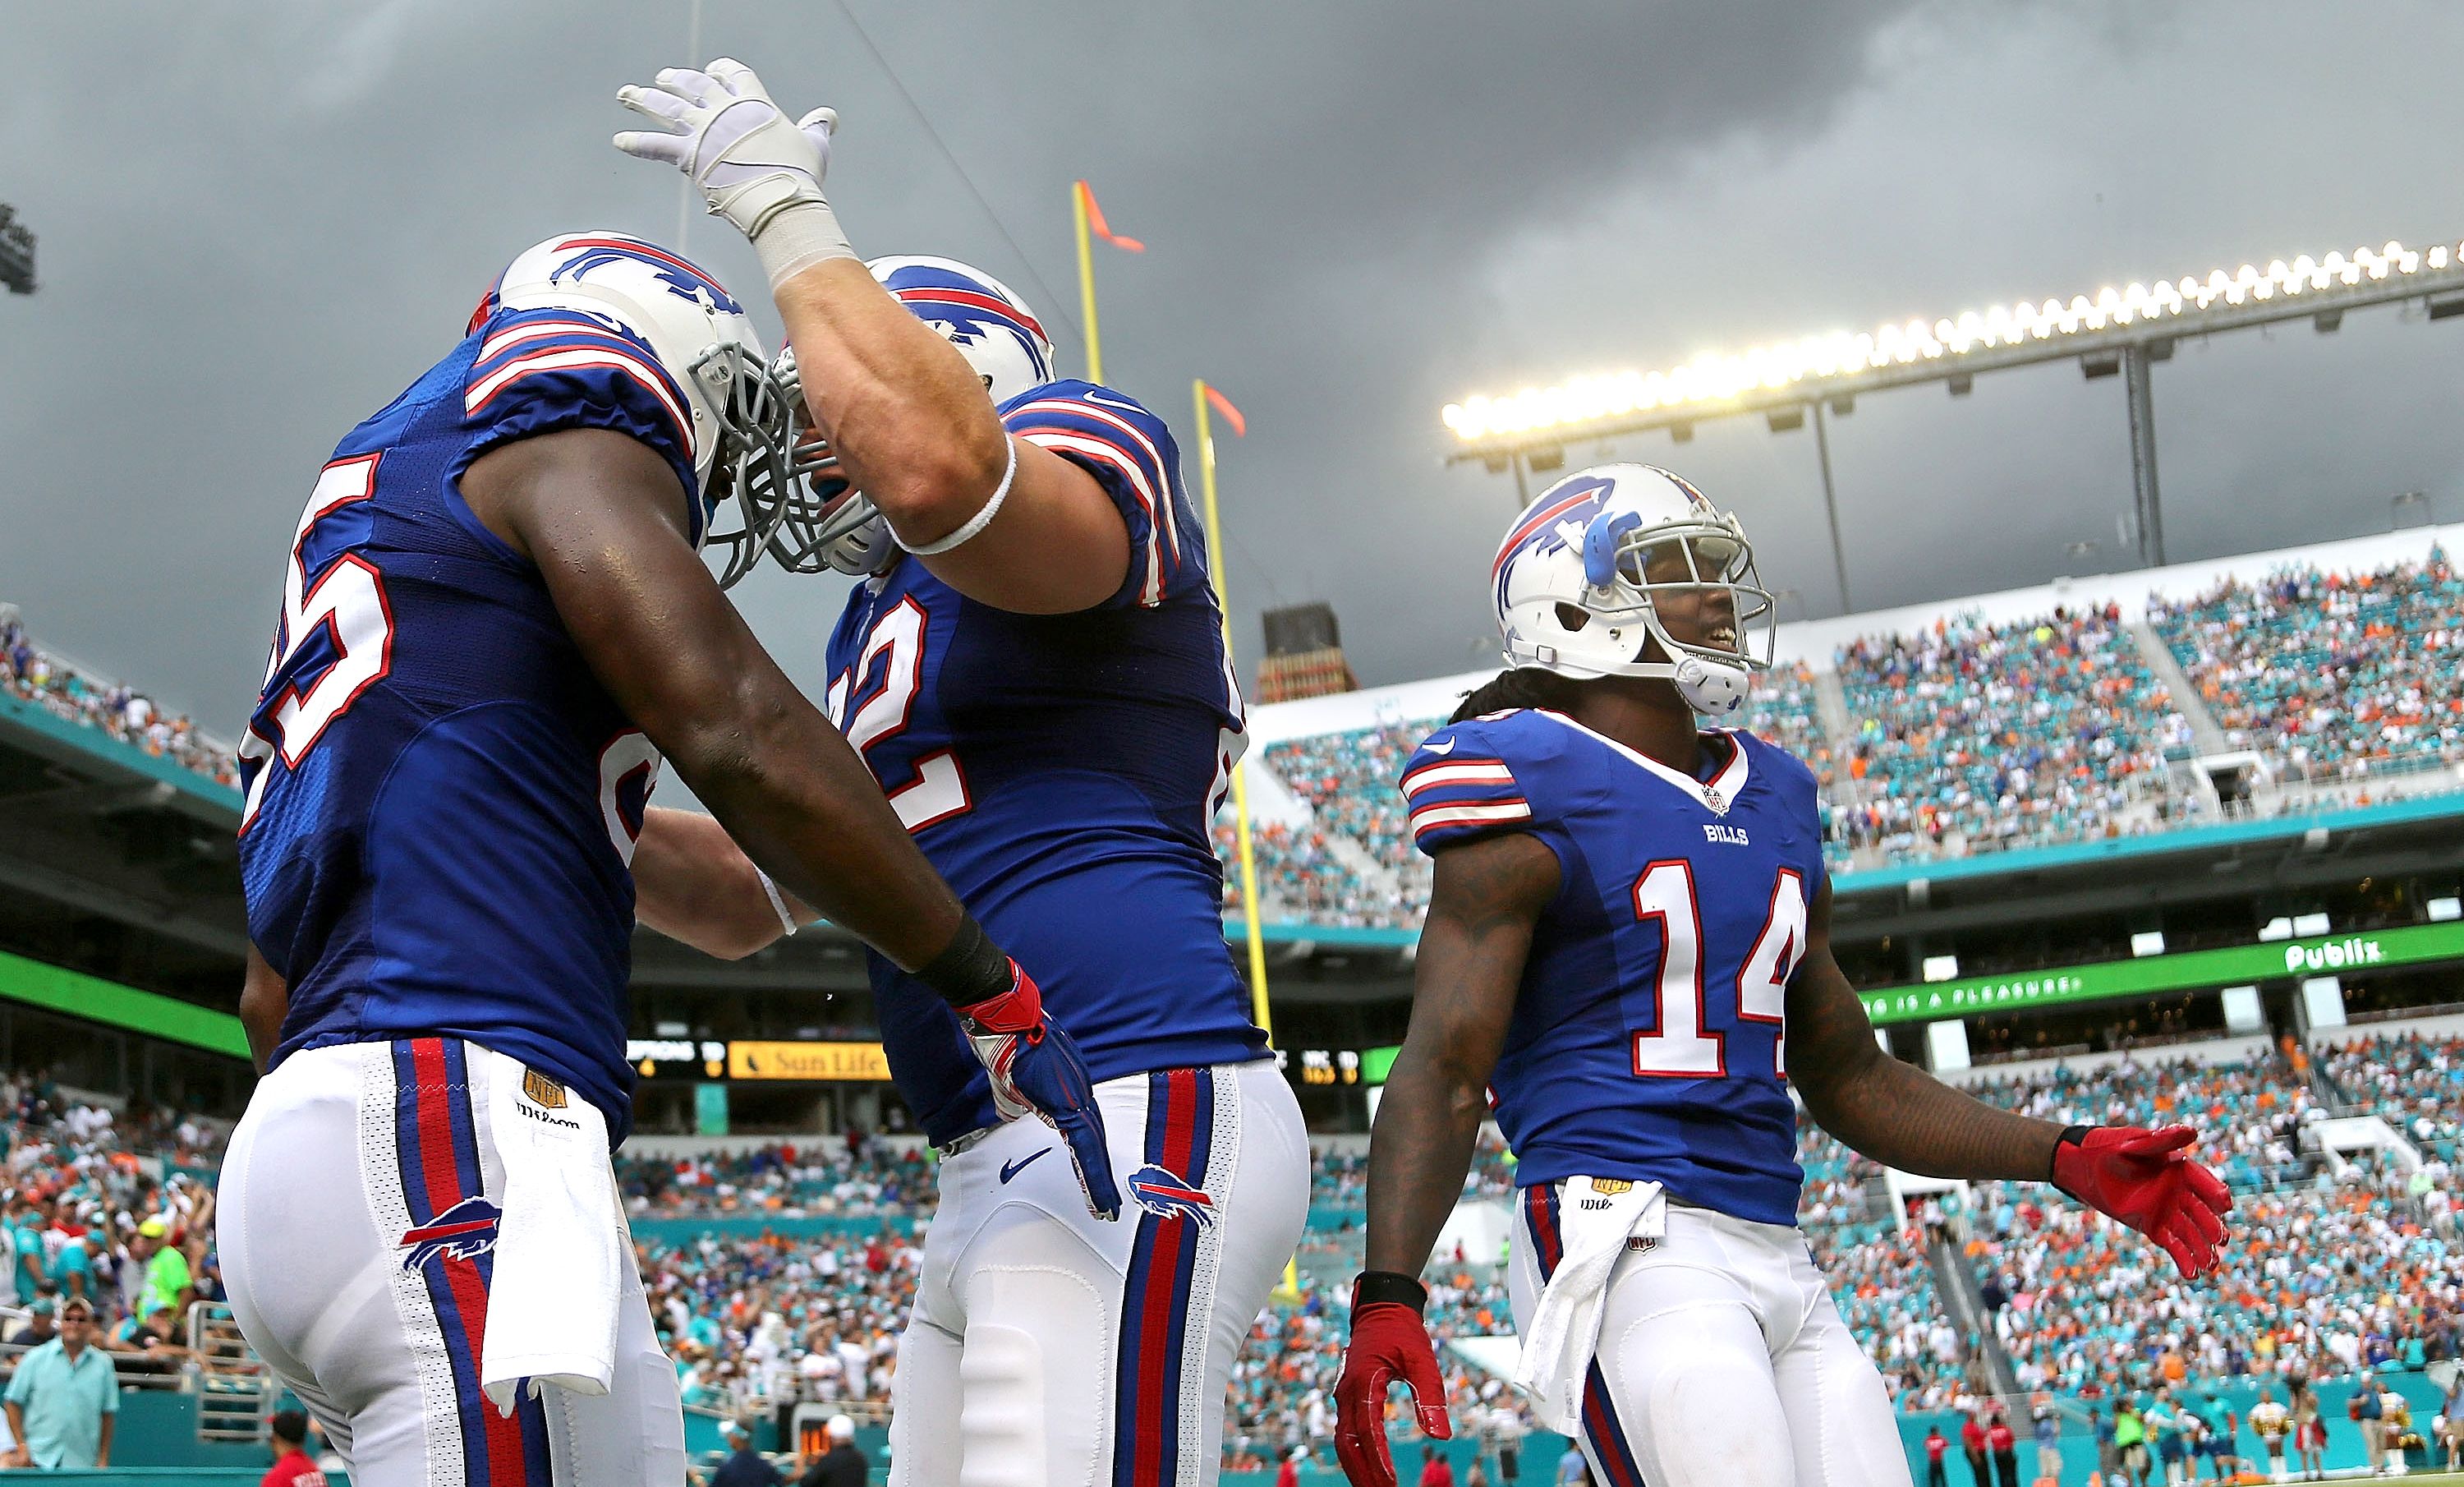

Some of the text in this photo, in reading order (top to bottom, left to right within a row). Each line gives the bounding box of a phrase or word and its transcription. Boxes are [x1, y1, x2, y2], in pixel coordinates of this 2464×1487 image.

[237, 453, 395, 838] 5
[828, 592, 973, 836] 2
[1702, 824, 1749, 846] BILLS
[1631, 858, 1809, 1079] 14
[2285, 937, 2379, 973] Publix
[775, 1050, 881, 1073] Sun Life
[1596, 1178, 1630, 1191] NFL
